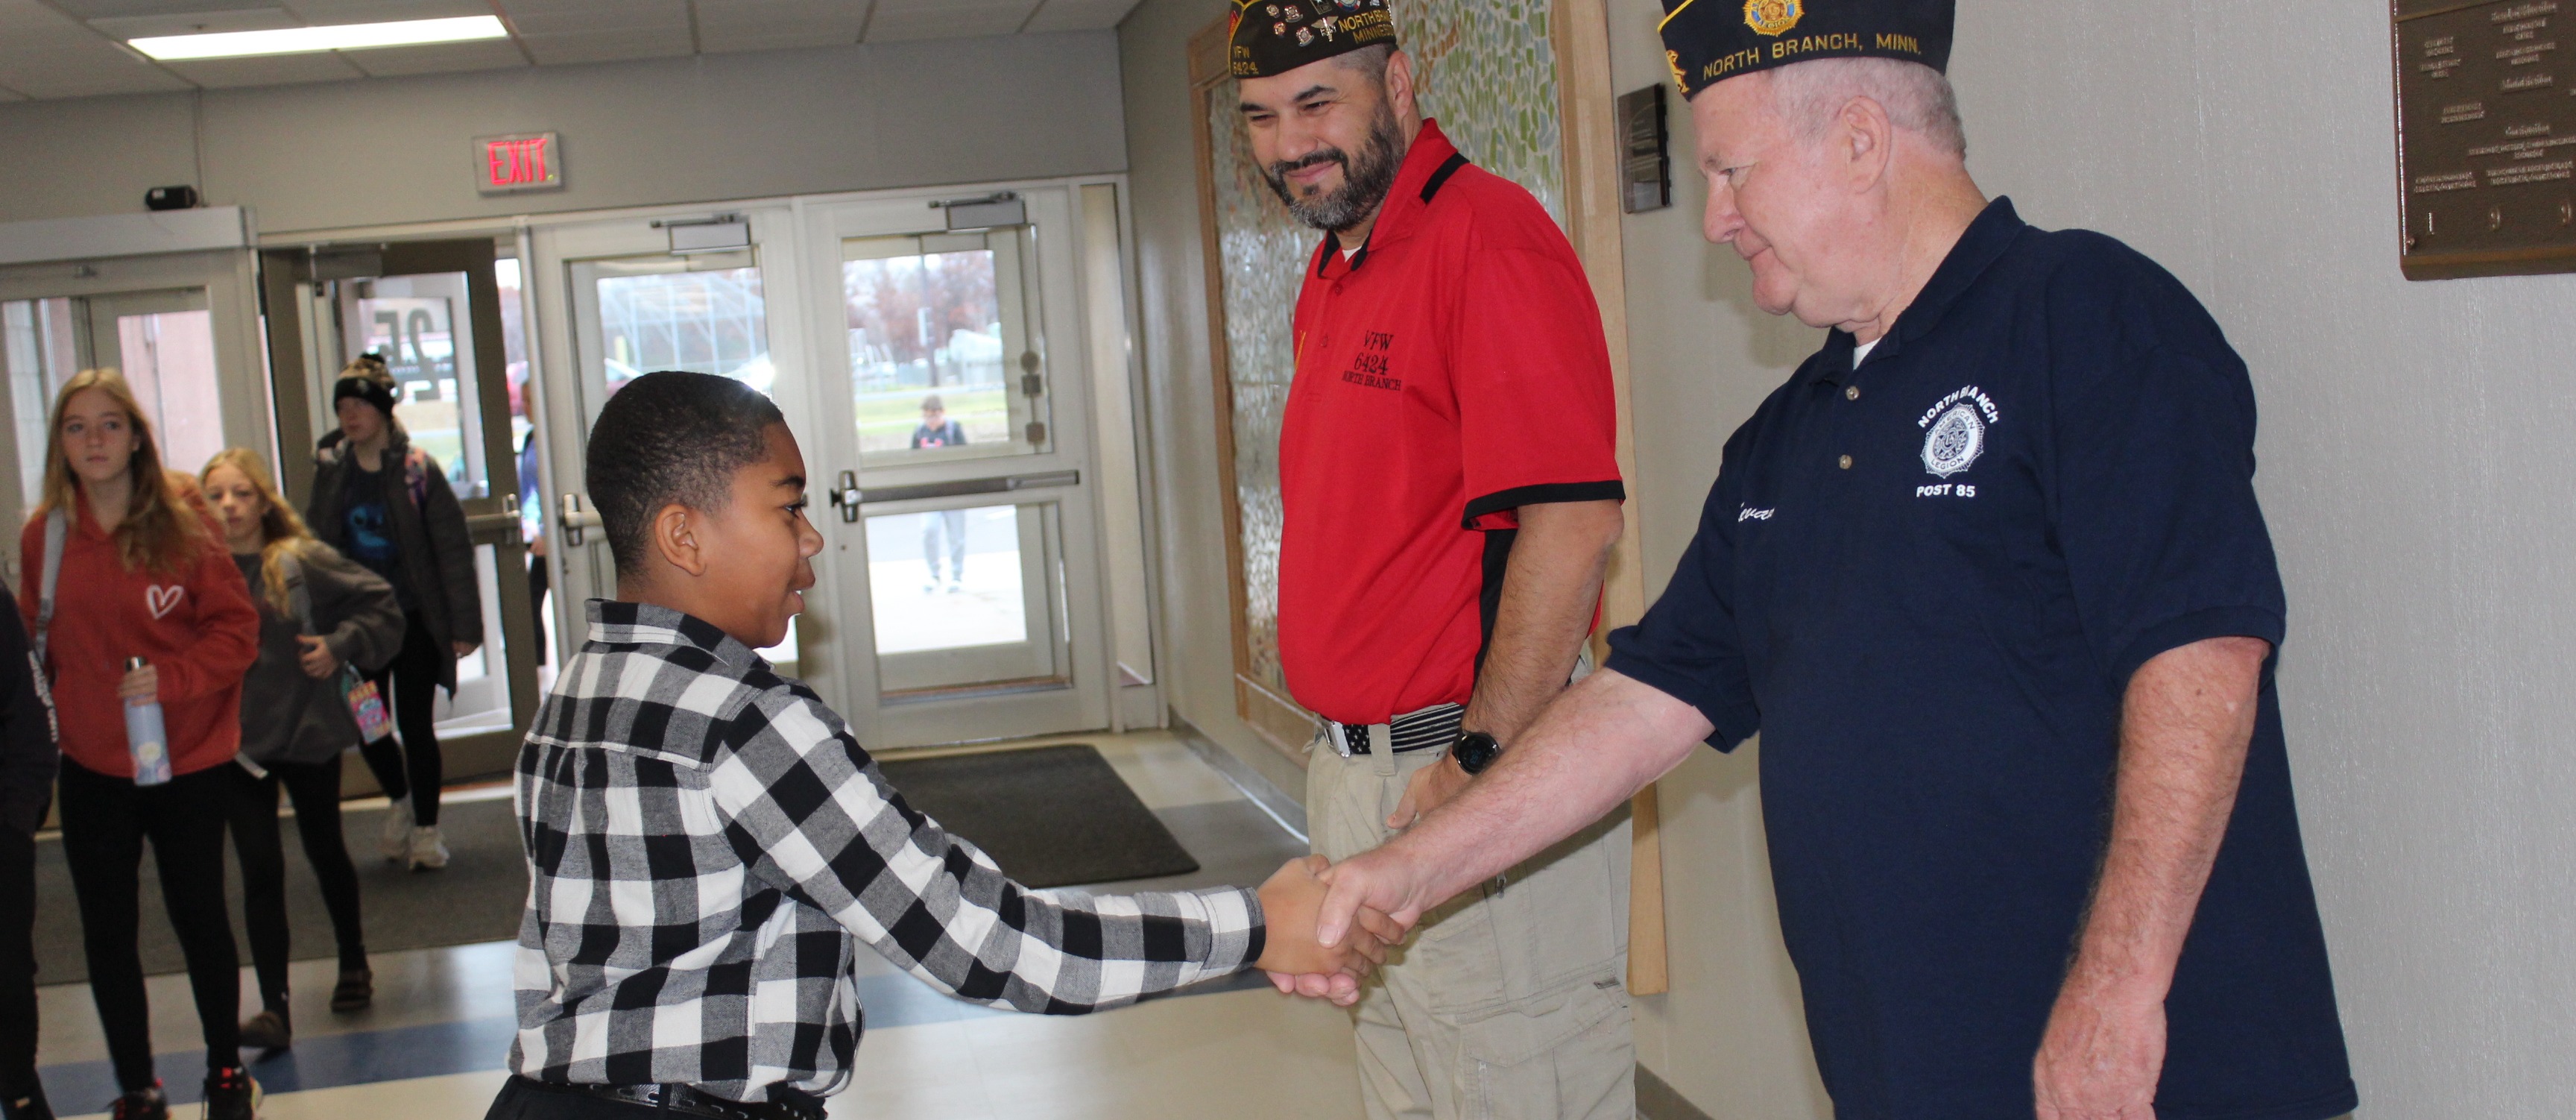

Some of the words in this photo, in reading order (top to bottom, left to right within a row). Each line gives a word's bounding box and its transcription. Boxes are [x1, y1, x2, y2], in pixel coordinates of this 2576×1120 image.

[1338, 11, 1375, 34] NORTH
[1703, 47, 1760, 81] NORTH
[1772, 34, 1863, 59] BRANCH,
[1876, 33, 1922, 55] MINN.
[487, 138, 548, 186] EXIT
[1364, 330, 1395, 351] VFW
[1354, 352, 1389, 375] 6424
[1365, 375, 1401, 391] BRANCH
[1918, 390, 1960, 428] NORTH
[1931, 456, 1964, 470] LEGION
[1916, 484, 1952, 497] POST
[1956, 485, 1976, 497] 85
